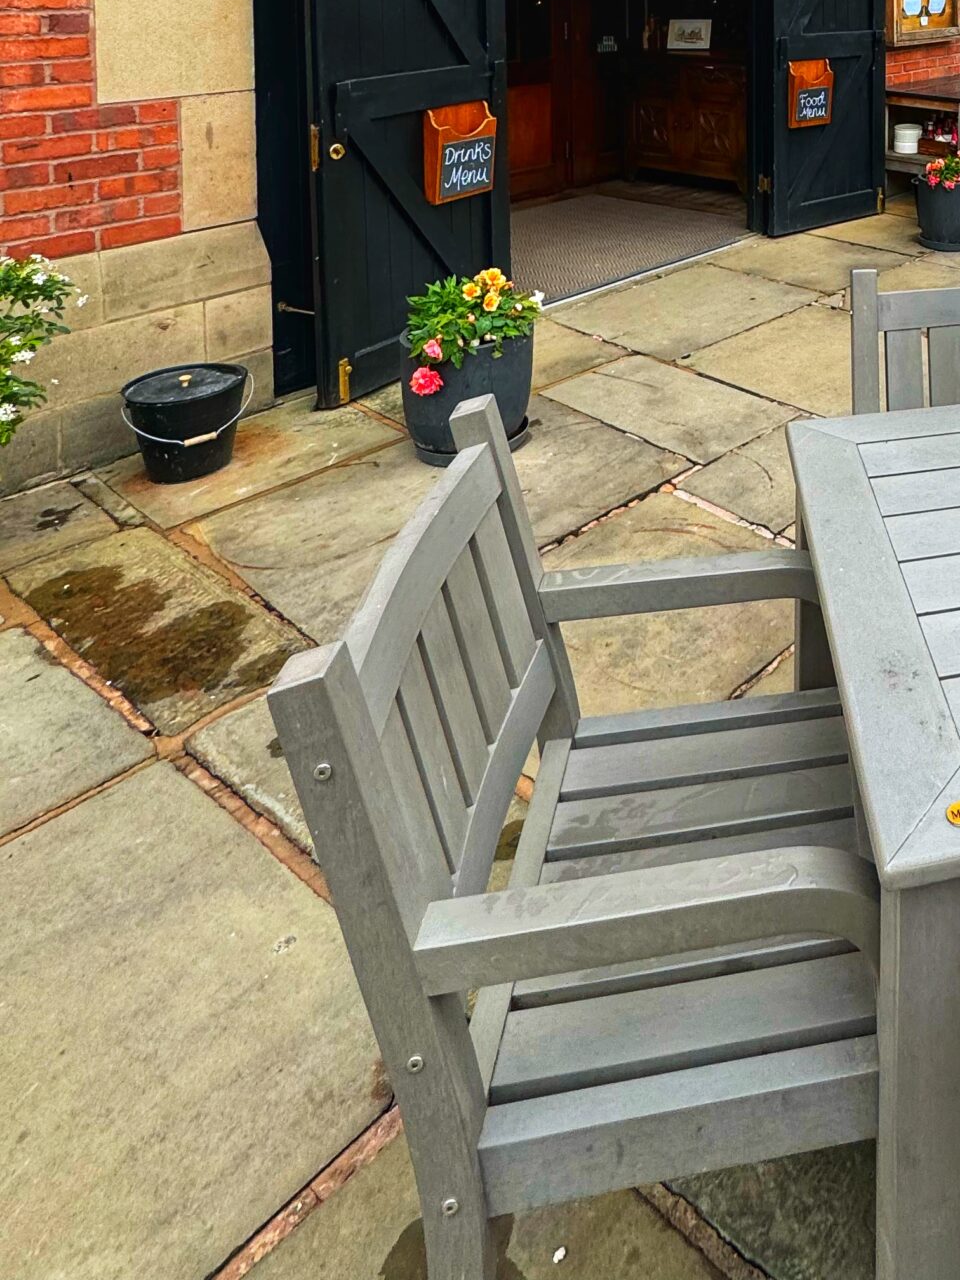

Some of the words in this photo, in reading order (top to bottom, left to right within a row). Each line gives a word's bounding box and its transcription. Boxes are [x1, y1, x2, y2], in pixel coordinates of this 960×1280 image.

[799, 91, 826, 107] Food
[800, 106, 826, 120] Menu
[445, 142, 492, 165] Drinks
[444, 165, 489, 191] Menu
